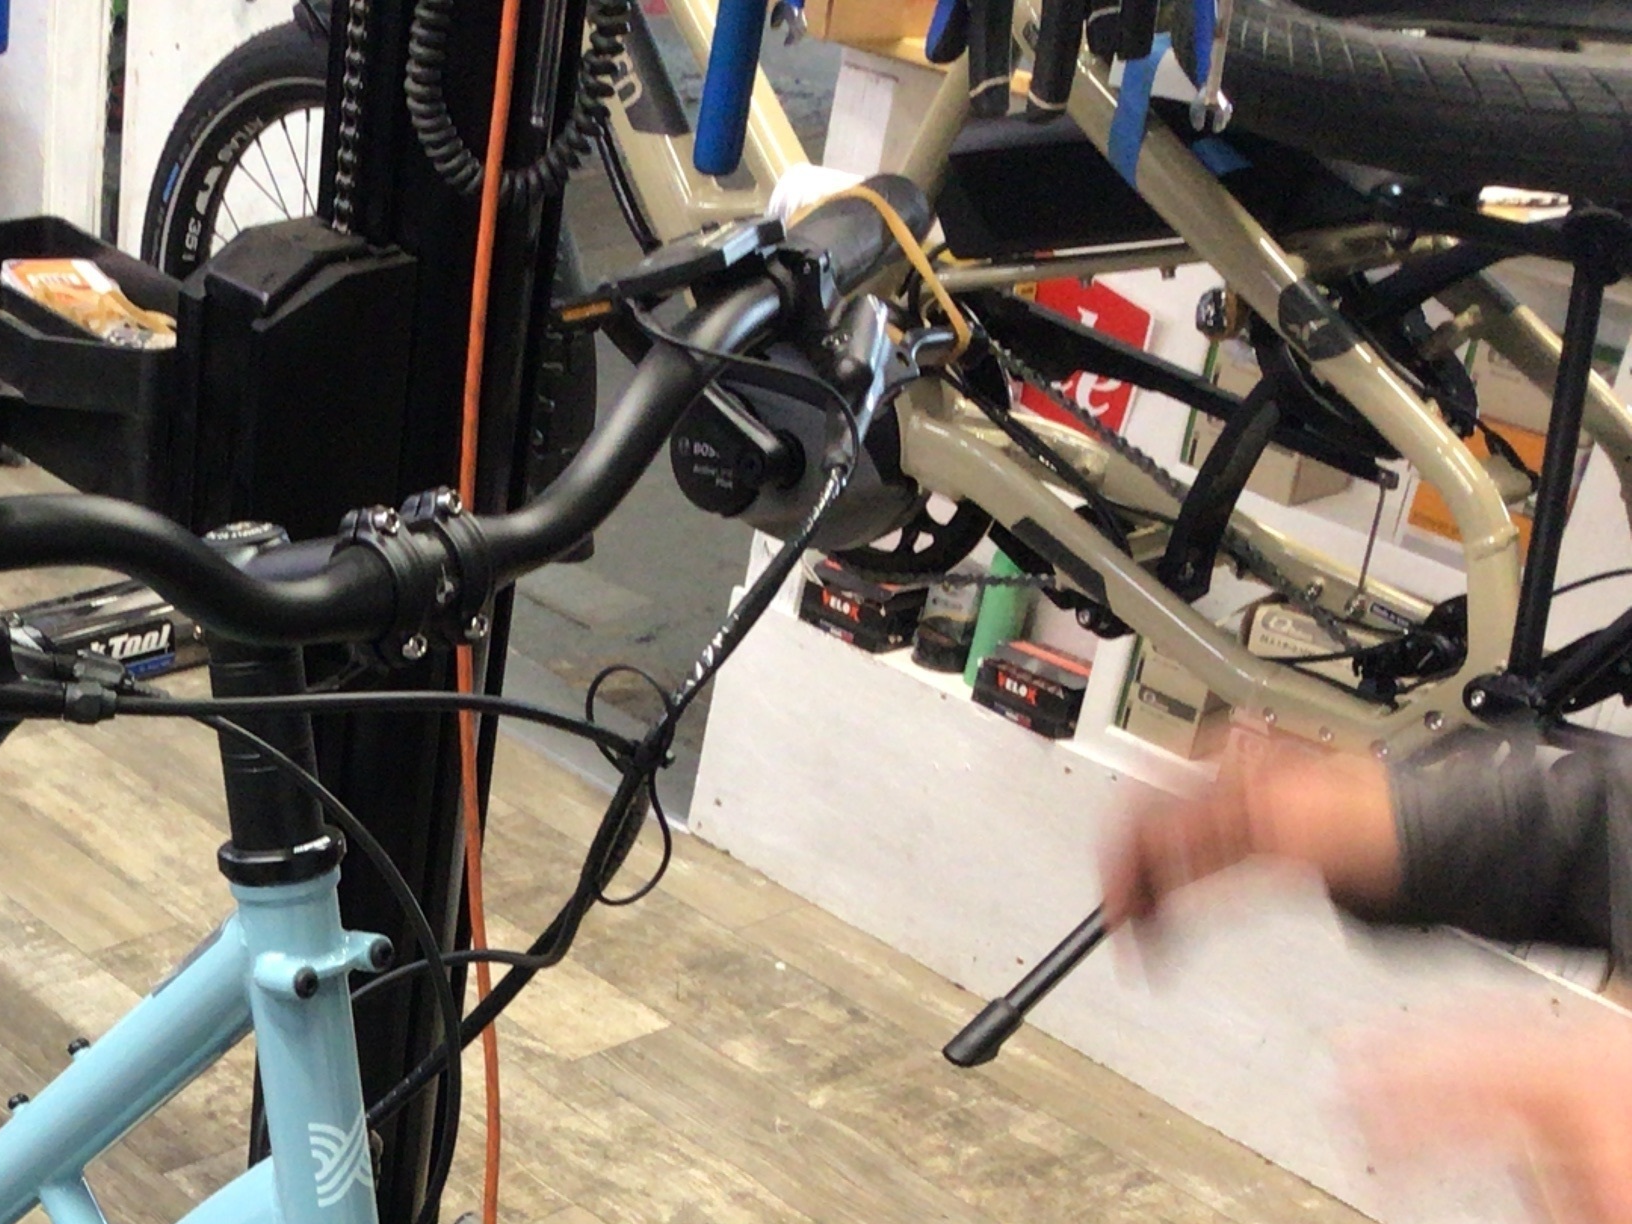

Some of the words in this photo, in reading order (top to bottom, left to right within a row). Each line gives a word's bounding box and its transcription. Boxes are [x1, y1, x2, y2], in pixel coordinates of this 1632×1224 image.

[821, 588, 860, 623] VELOX
[109, 623, 171, 660] Tool
[997, 671, 1037, 706] VELOX
